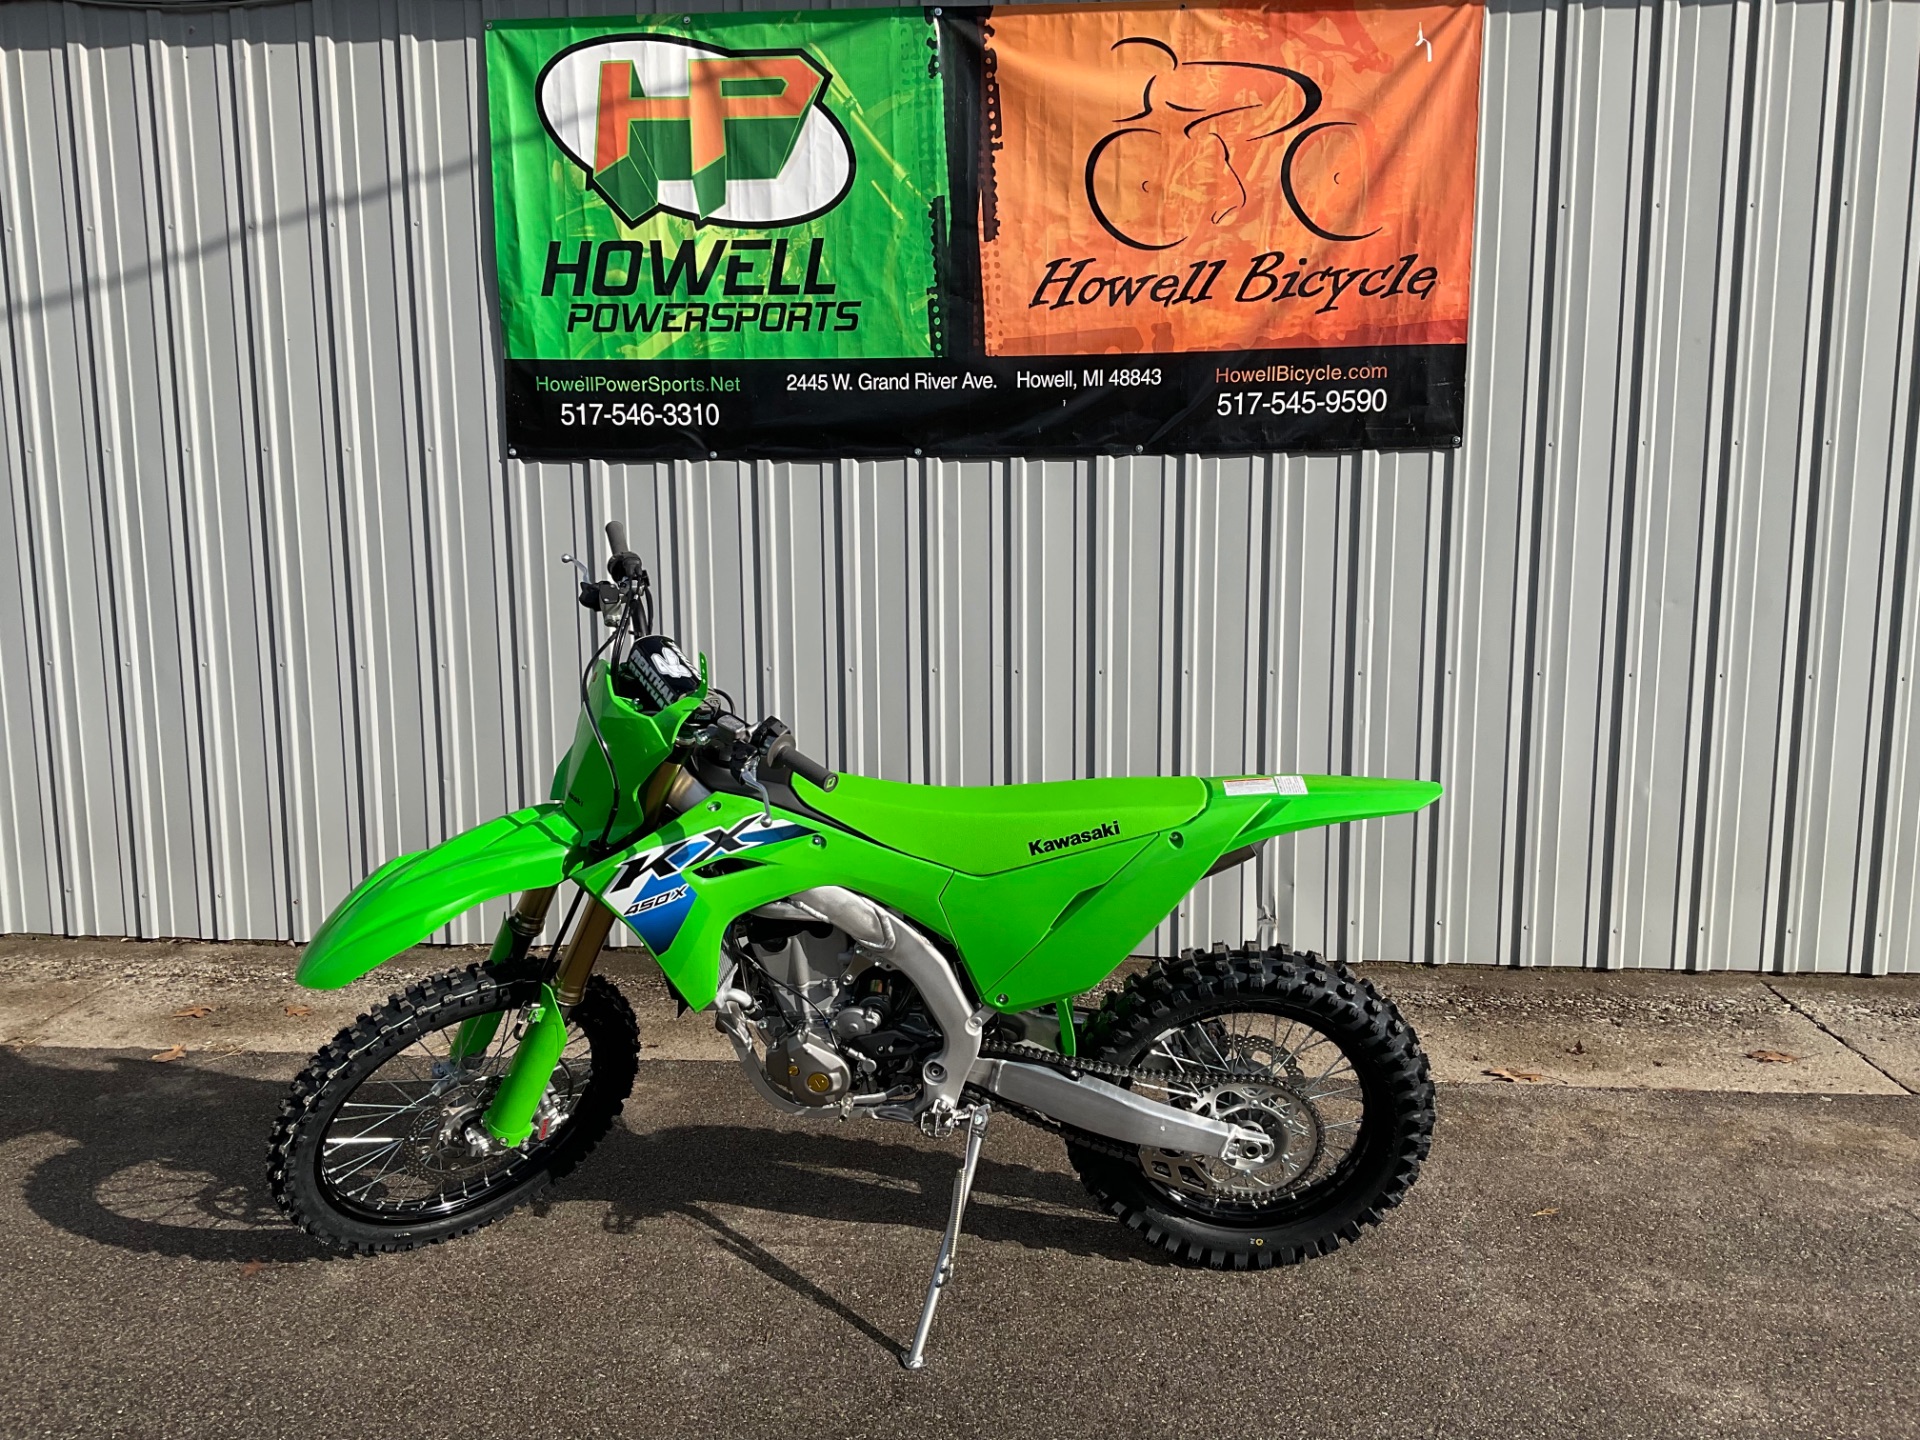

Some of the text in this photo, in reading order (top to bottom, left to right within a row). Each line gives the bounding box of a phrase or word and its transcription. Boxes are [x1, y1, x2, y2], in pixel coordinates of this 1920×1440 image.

[592, 55, 824, 219] HP
[540, 237, 837, 297] HOWELL
[1028, 250, 1439, 316] Howell Bicycle
[566, 300, 863, 333] POWERSPORTS
[535, 375, 741, 396] HowellPowerSports.Net
[786, 371, 998, 391] 2445 W. Grand River Ave.
[1016, 367, 1163, 390] Howell, MI 48843
[1215, 364, 1389, 385] HowellBicycle.com
[560, 402, 721, 427] 517-546-3310
[1216, 387, 1389, 417] 517-545-9590
[630, 649, 675, 706] RENTHAL
[609, 812, 765, 894] KX
[1028, 820, 1121, 857] Kawasaki
